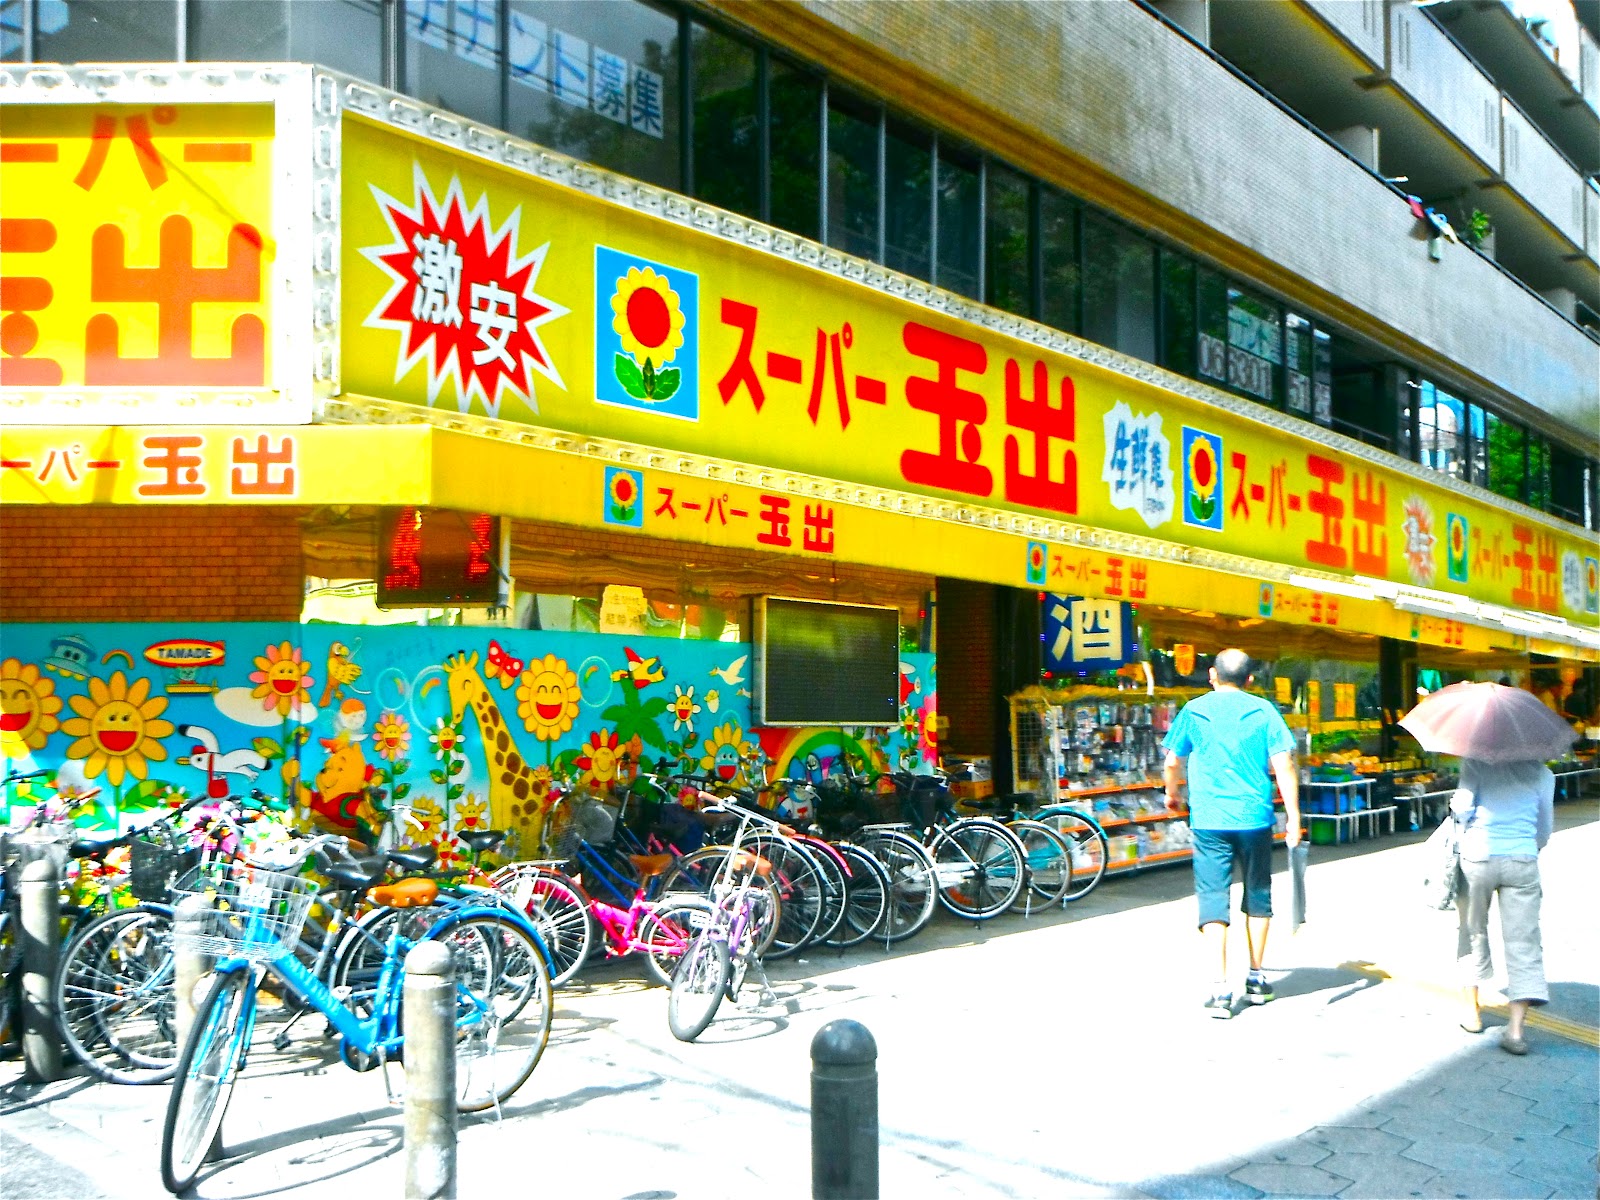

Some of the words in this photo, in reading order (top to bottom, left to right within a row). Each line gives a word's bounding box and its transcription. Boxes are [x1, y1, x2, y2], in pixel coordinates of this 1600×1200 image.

[412, 231, 518, 373] 激安
[717, 298, 1079, 515] スーパー玉出
[654, 487, 835, 553] スーパー玉出
[1230, 451, 1389, 577] スーパー玉出
[1051, 554, 1148, 599] スーパー玉出
[157, 647, 212, 659] TAMADE
[1050, 592, 1122, 662] 酒
